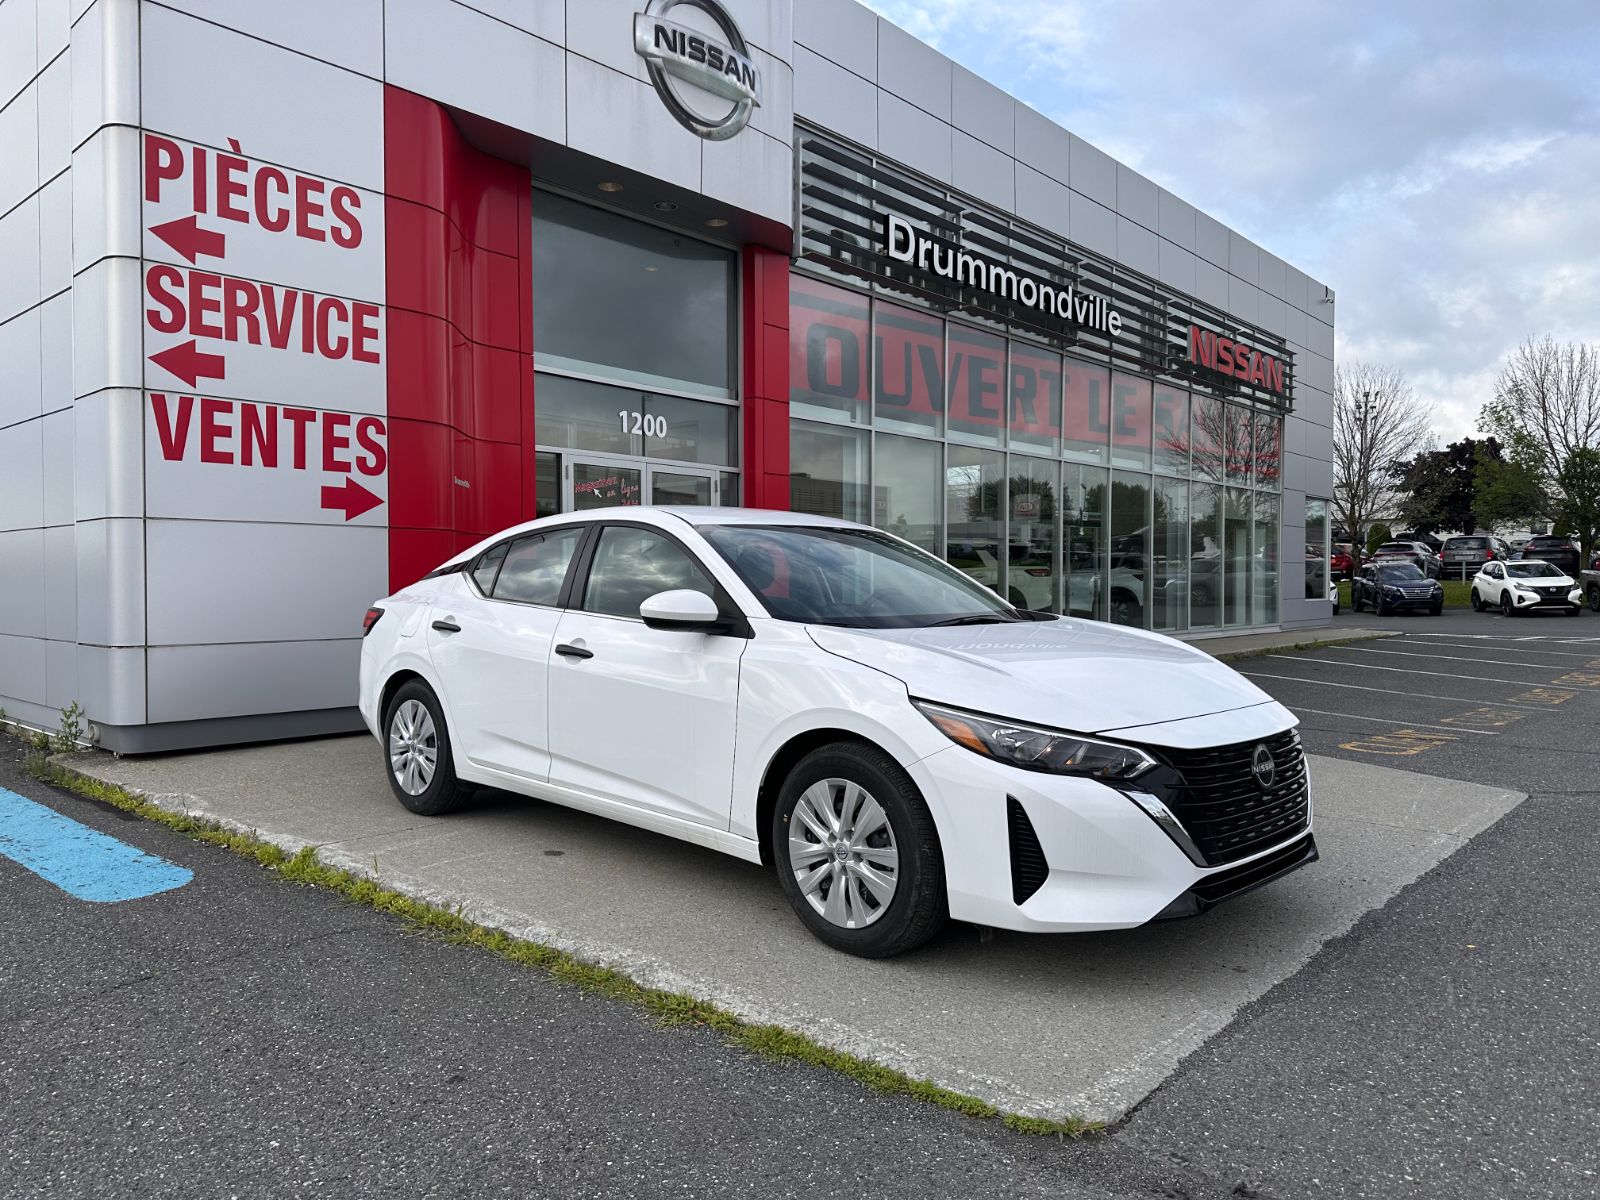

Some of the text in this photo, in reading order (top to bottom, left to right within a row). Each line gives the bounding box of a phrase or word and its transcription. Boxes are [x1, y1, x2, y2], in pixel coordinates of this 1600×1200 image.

[654, 23, 756, 92] NISSAN
[145, 136, 362, 248] PIÈCES
[147, 266, 380, 363] SERVICE
[888, 214, 1122, 336] Drummondville
[806, 322, 1071, 428] OUVERT
[1088, 379, 1137, 437] LE
[1187, 324, 1284, 393] NISSAN
[152, 394, 388, 478] VENTES
[619, 410, 667, 438] 1200
